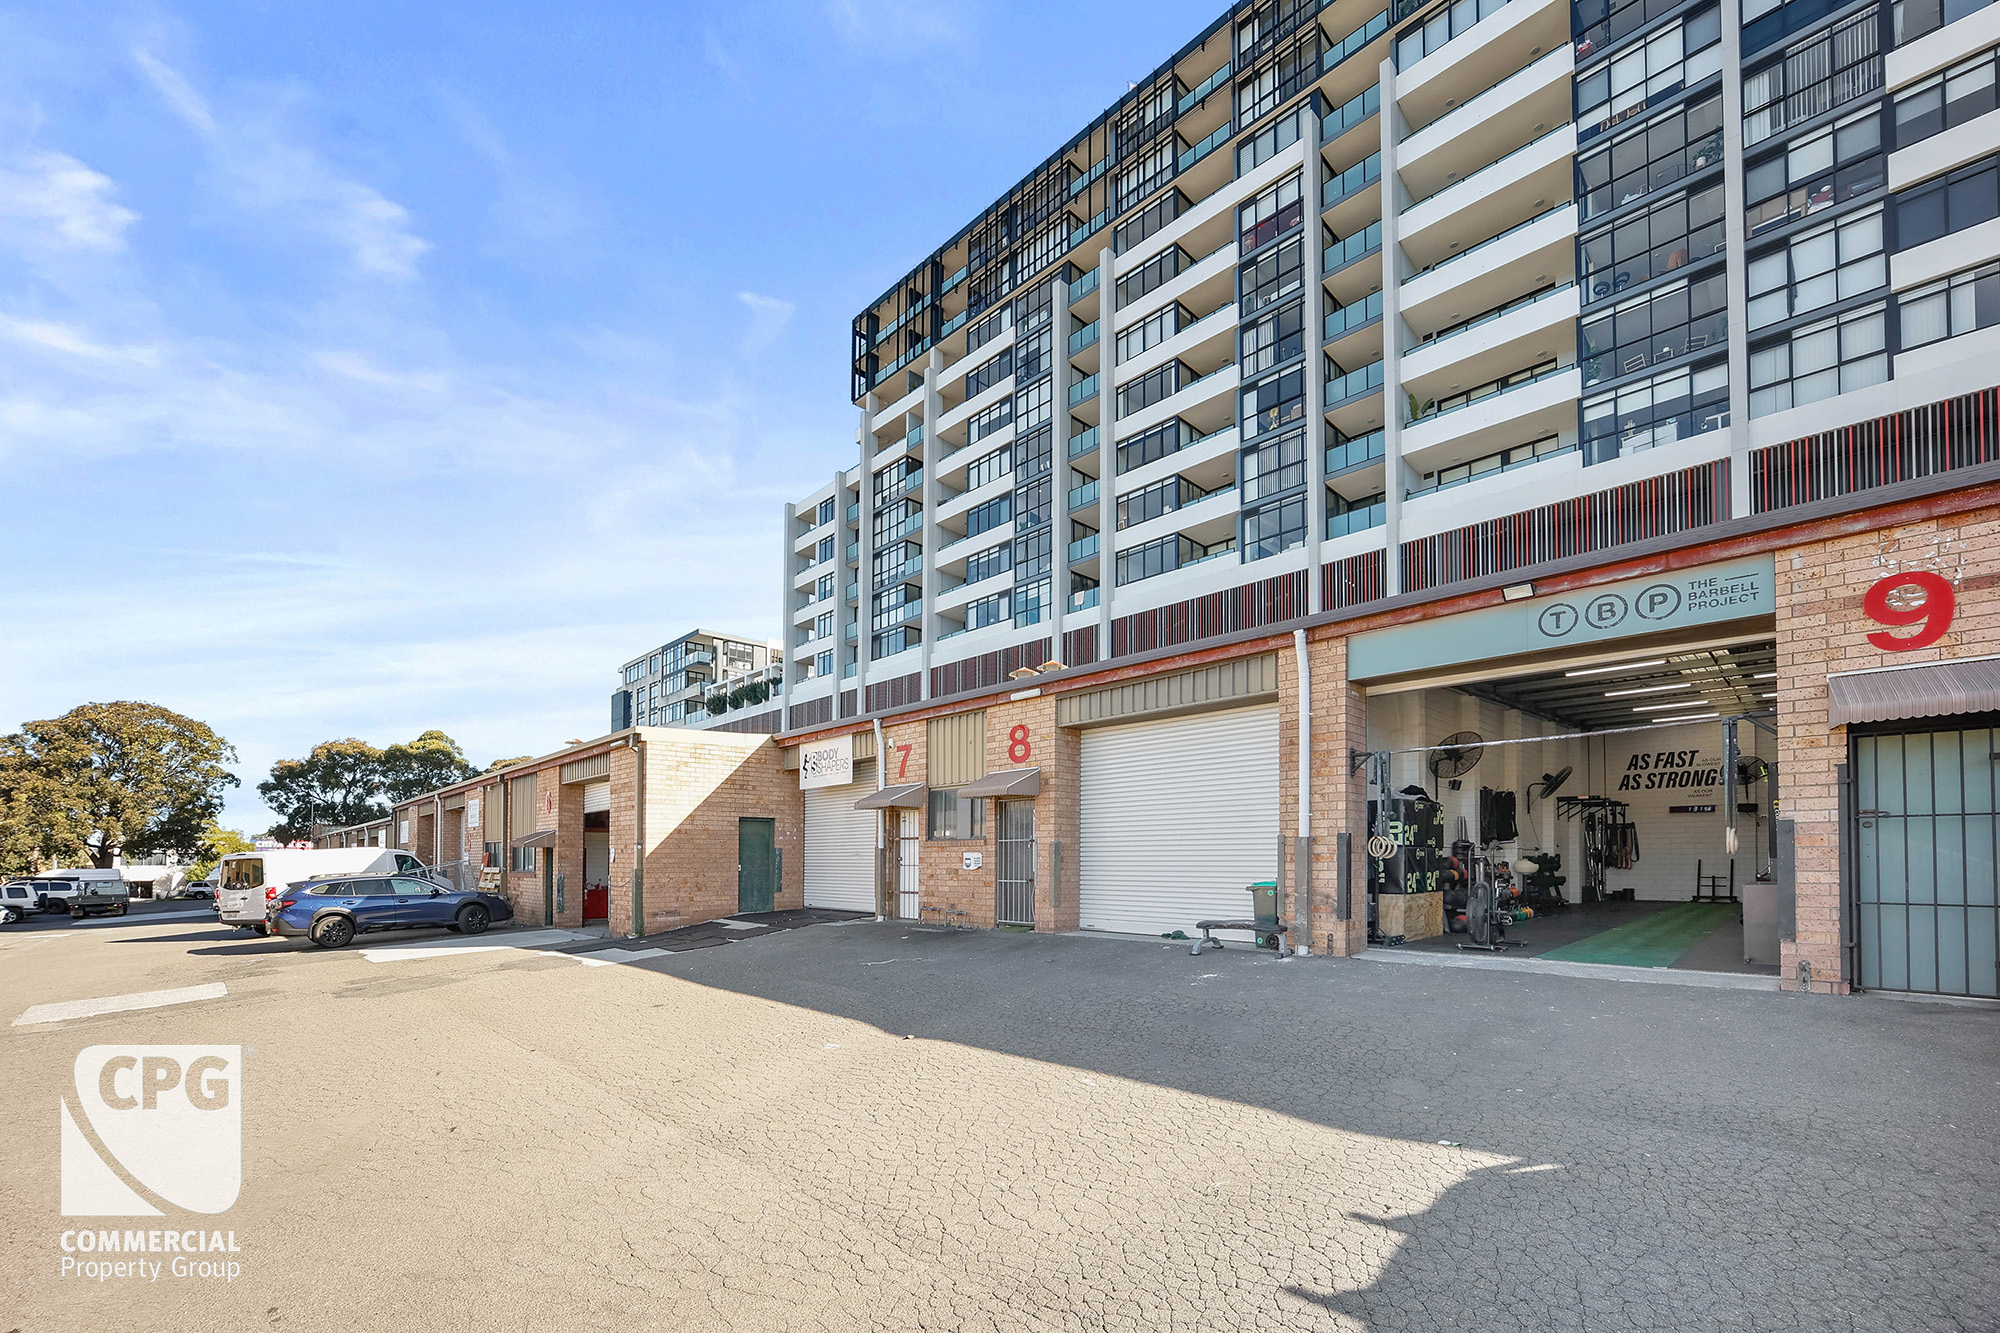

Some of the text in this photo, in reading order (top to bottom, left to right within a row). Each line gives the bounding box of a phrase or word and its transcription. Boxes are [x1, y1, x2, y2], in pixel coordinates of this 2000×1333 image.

[1688, 577, 1718, 590] THE
[1688, 581, 1760, 602] BARBELL
[1688, 591, 1760, 612] PROJECT
[1863, 570, 1956, 652] 9
[817, 747, 839, 761] BODY
[1008, 724, 1031, 764] 8
[817, 757, 850, 774] SHAPERS
[896, 744, 913, 779] 7
[1626, 749, 1700, 771] AS FAST
[1618, 768, 1718, 791] AS STRONG
